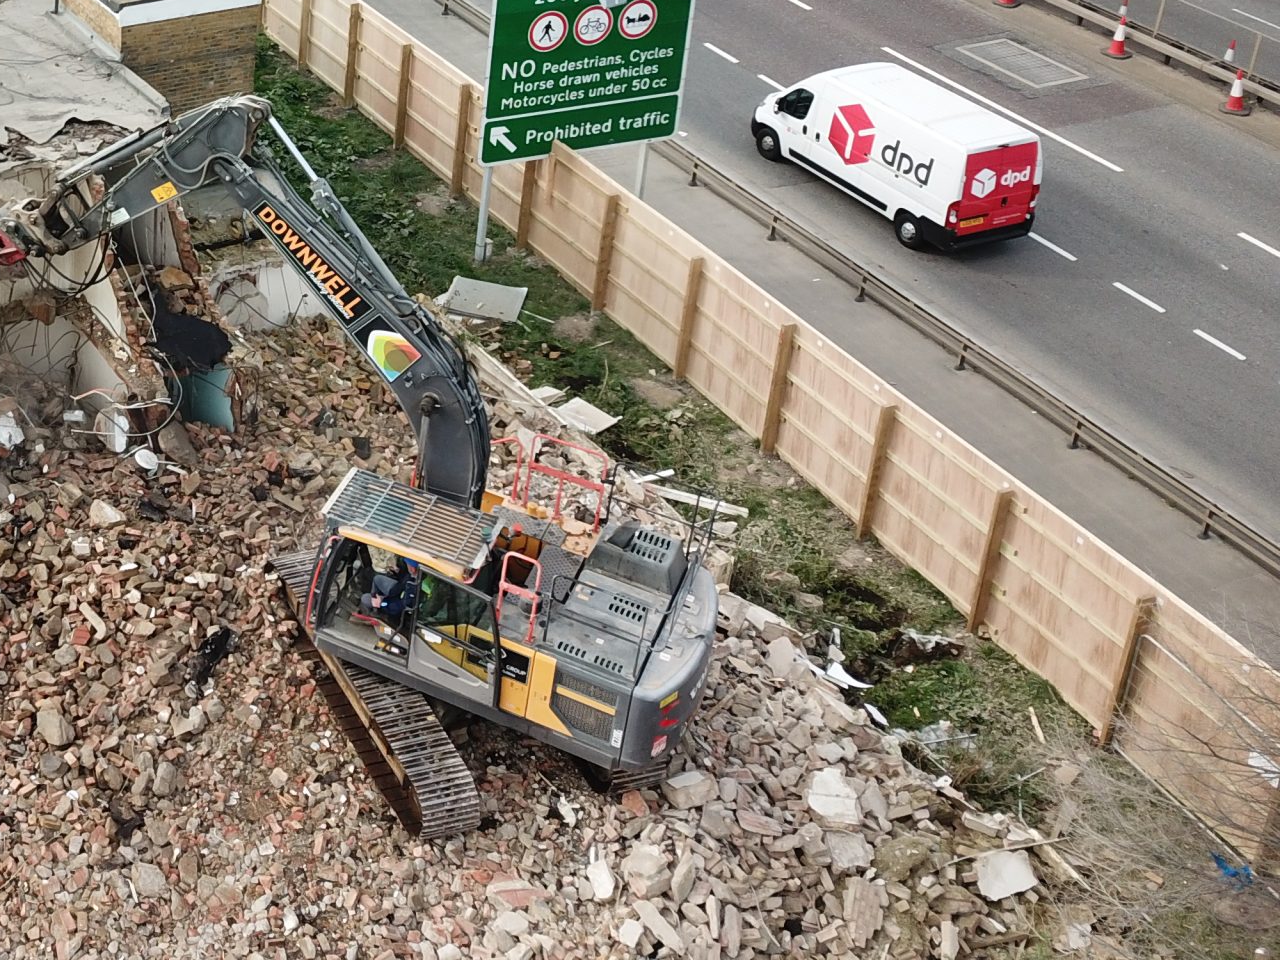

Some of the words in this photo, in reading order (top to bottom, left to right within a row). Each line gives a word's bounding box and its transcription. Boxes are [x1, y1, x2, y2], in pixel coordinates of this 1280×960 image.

[501, 59, 536, 81] NO
[629, 46, 674, 65] Cycles
[513, 75, 554, 94] Horse
[559, 72, 601, 88] drawn
[605, 63, 659, 81] vehicles
[500, 88, 584, 111] Motorcycles
[588, 83, 627, 98] under
[631, 78, 649, 91] 50
[652, 77, 668, 89] cc
[525, 118, 612, 145] Prohibited
[619, 111, 670, 130] traffic
[881, 140, 934, 186] dpd
[1000, 165, 1031, 188] dpd
[258, 206, 362, 318] DOWNWELL
